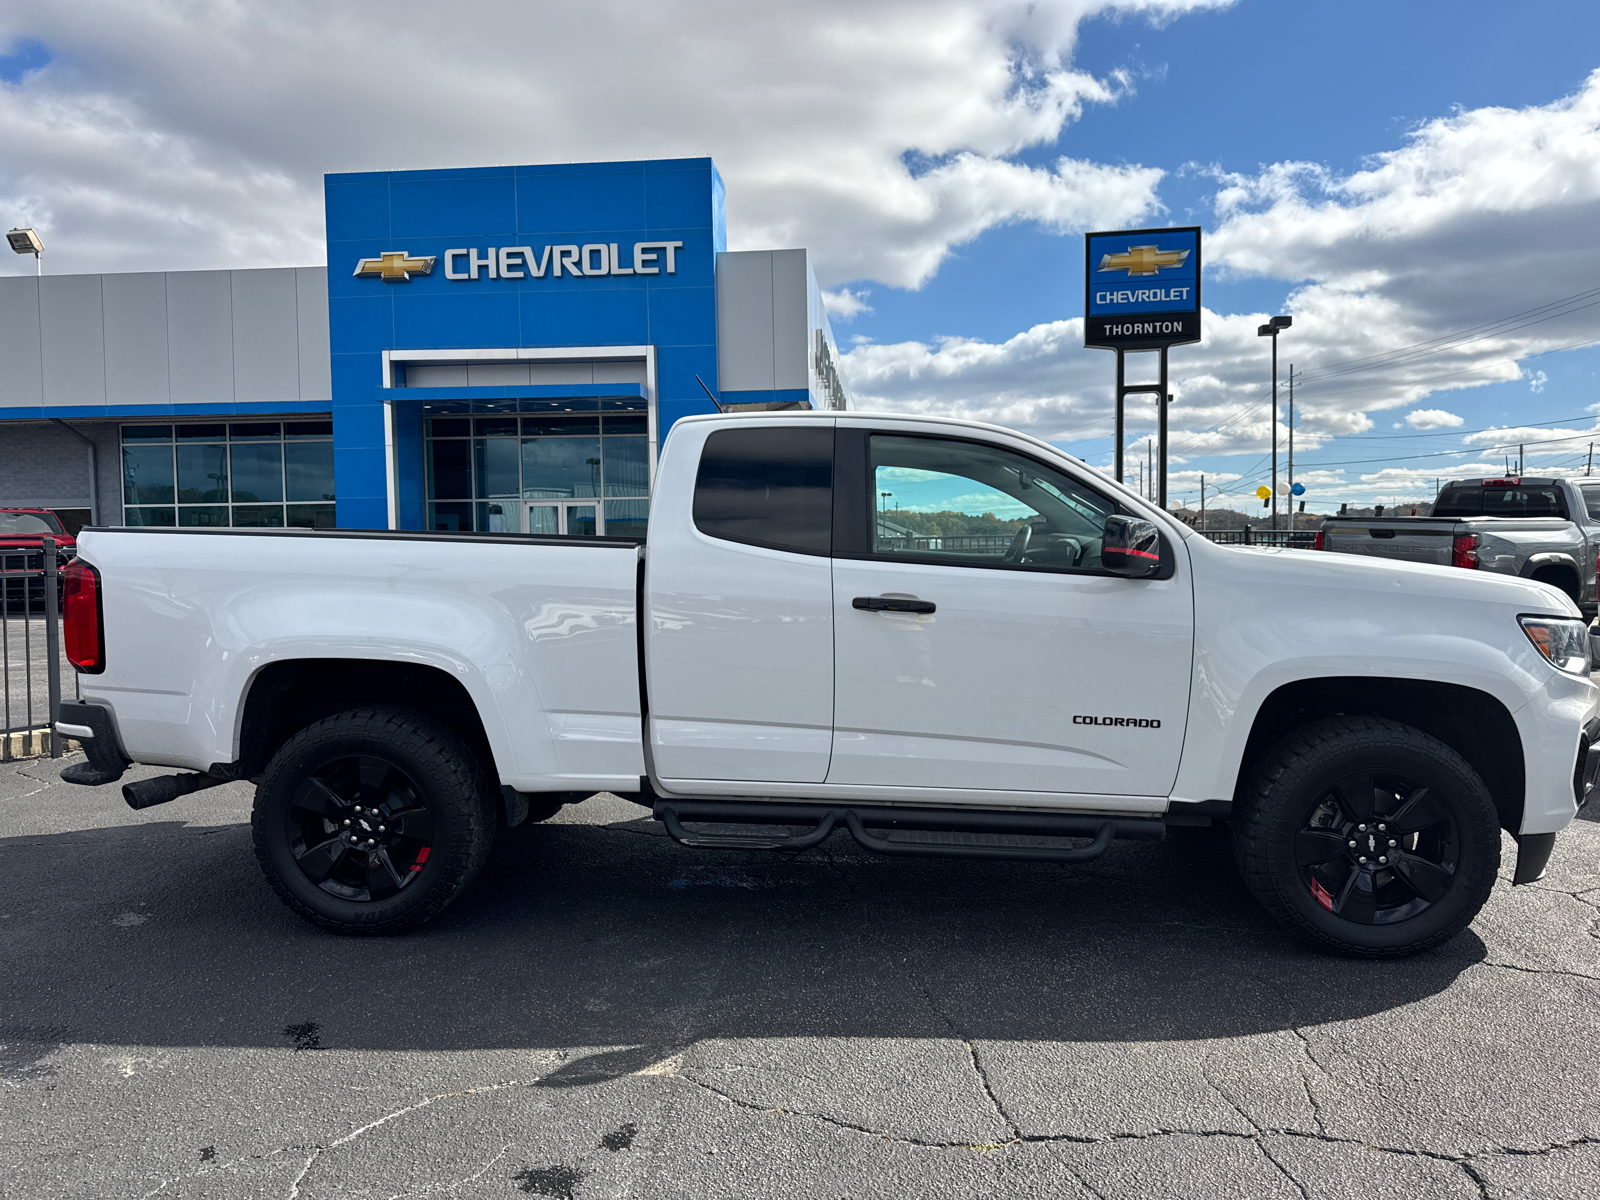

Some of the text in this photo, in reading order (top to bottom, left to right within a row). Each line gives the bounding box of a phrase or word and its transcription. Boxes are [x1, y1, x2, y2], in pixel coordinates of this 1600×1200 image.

[444, 240, 683, 280] CHEVROLET
[1096, 287, 1190, 305] CHEVROLET
[1103, 321, 1183, 336] THORNTON
[1332, 543, 1434, 555] CHEVROLET
[1072, 715, 1161, 729] COLORADO
